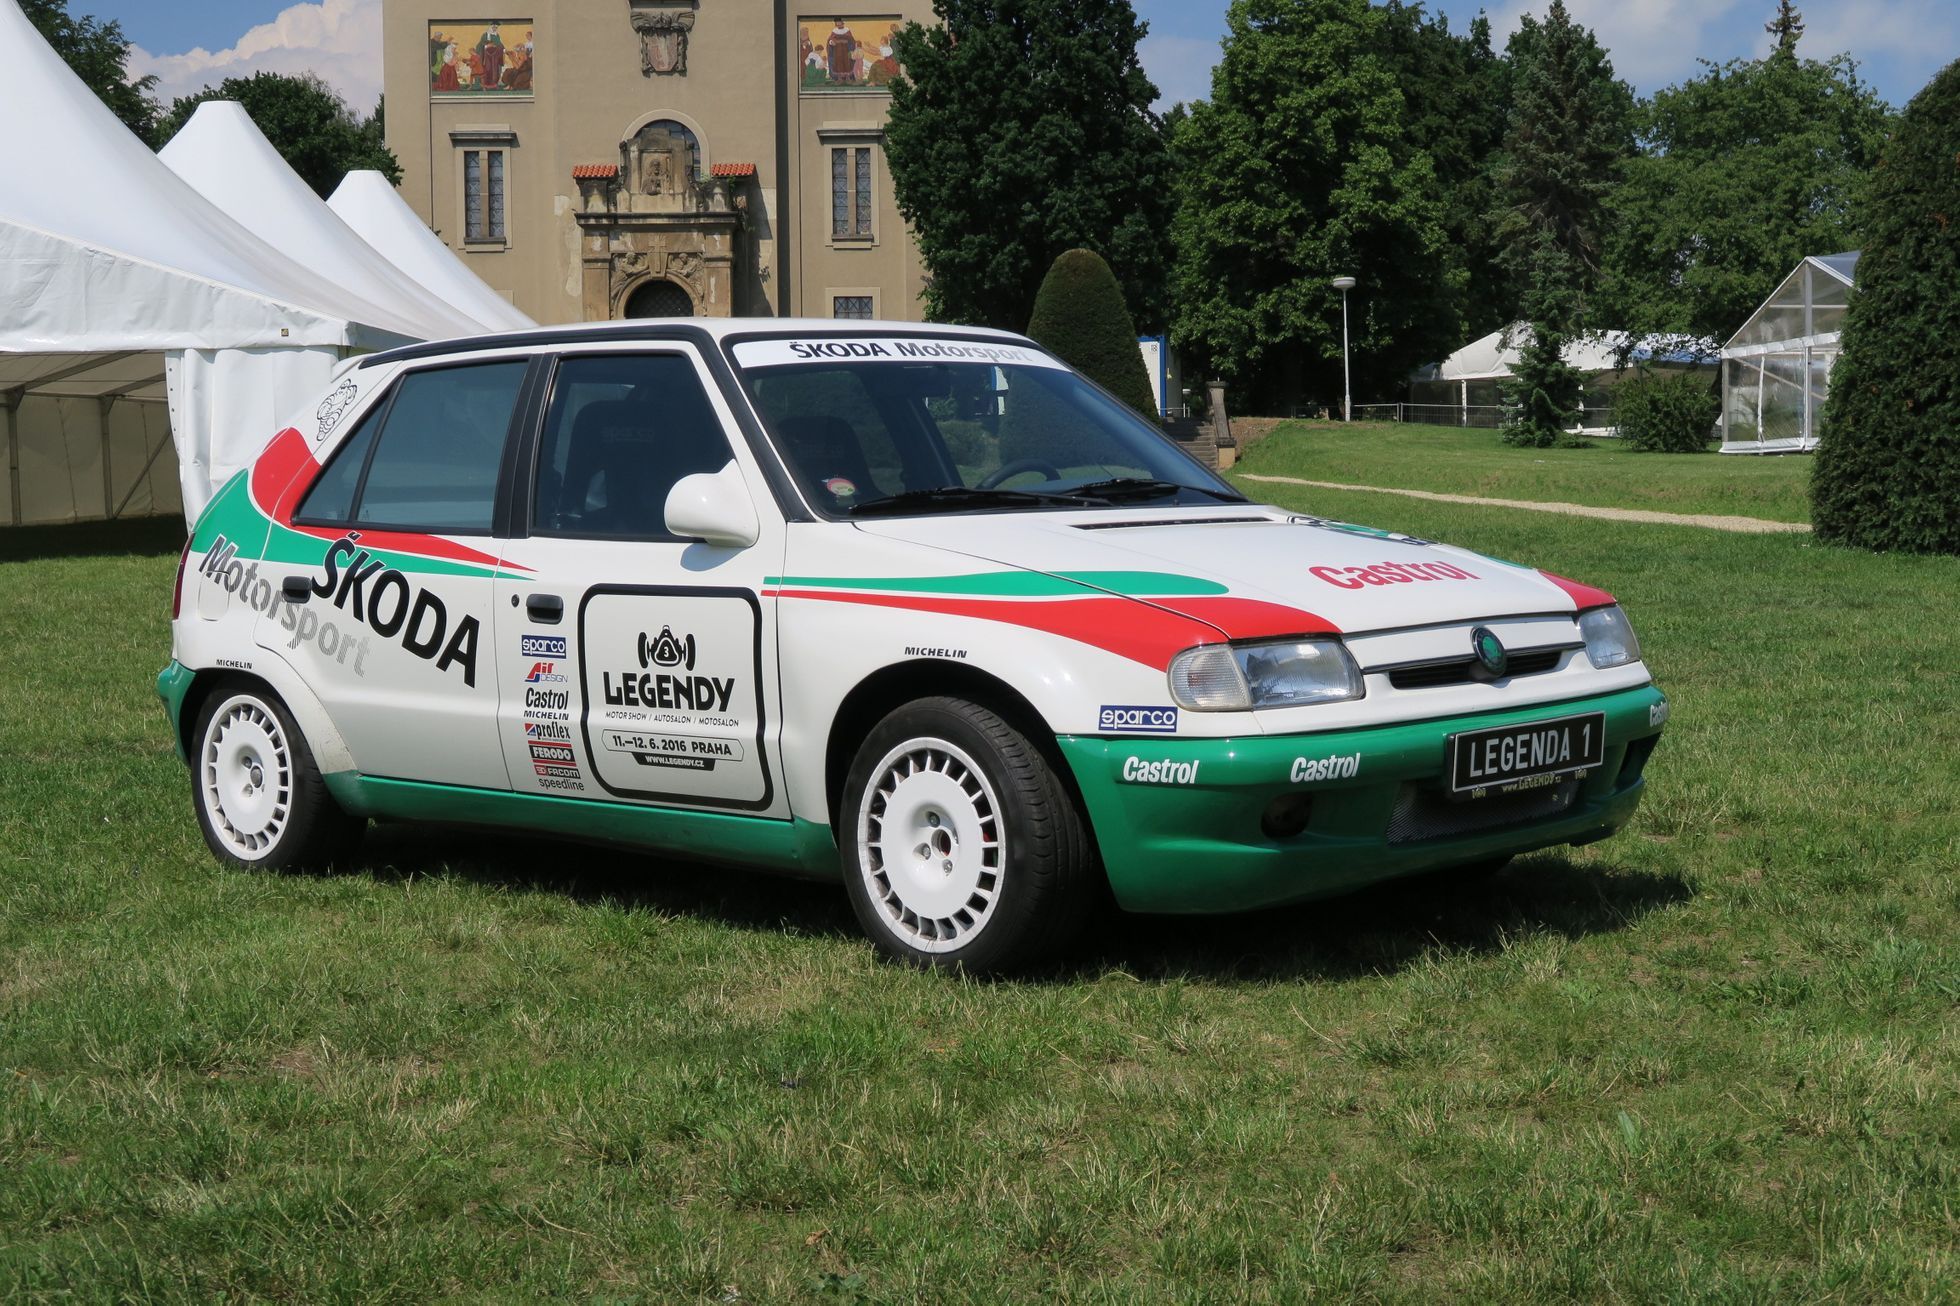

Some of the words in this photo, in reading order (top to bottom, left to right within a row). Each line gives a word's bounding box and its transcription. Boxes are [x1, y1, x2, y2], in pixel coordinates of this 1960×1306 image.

[789, 341, 892, 359] ŠKODA
[893, 342, 1033, 363] Motorsport
[1308, 560, 1481, 590] Castrol
[199, 534, 371, 678] Motorsport
[311, 531, 480, 689] ŠKODA
[522, 638, 565, 655] sparco
[663, 646, 669, 658] 3
[904, 646, 968, 659] MICHELIN
[215, 659, 253, 669] MICHELIN
[540, 673, 568, 683] DESIGN
[525, 687, 569, 710] Castrol
[603, 671, 735, 712] LEGENDY
[523, 710, 569, 720] MICHELIN
[605, 711, 627, 719] MOTOR
[628, 712, 647, 720] SHOW
[654, 714, 691, 724] AUTOSALON
[699, 716, 739, 727] MOTOSALON
[1101, 709, 1175, 729] sparco
[535, 721, 571, 740] proflex
[532, 746, 571, 760] FERODO
[661, 739, 687, 752] 2016
[691, 741, 733, 755] PRAHA
[1470, 727, 1570, 777] LEGENDA
[1582, 723, 1591, 757] 1
[1123, 756, 1199, 784] Castrol
[1290, 752, 1361, 783] Castrol
[538, 778, 585, 791] speedline
